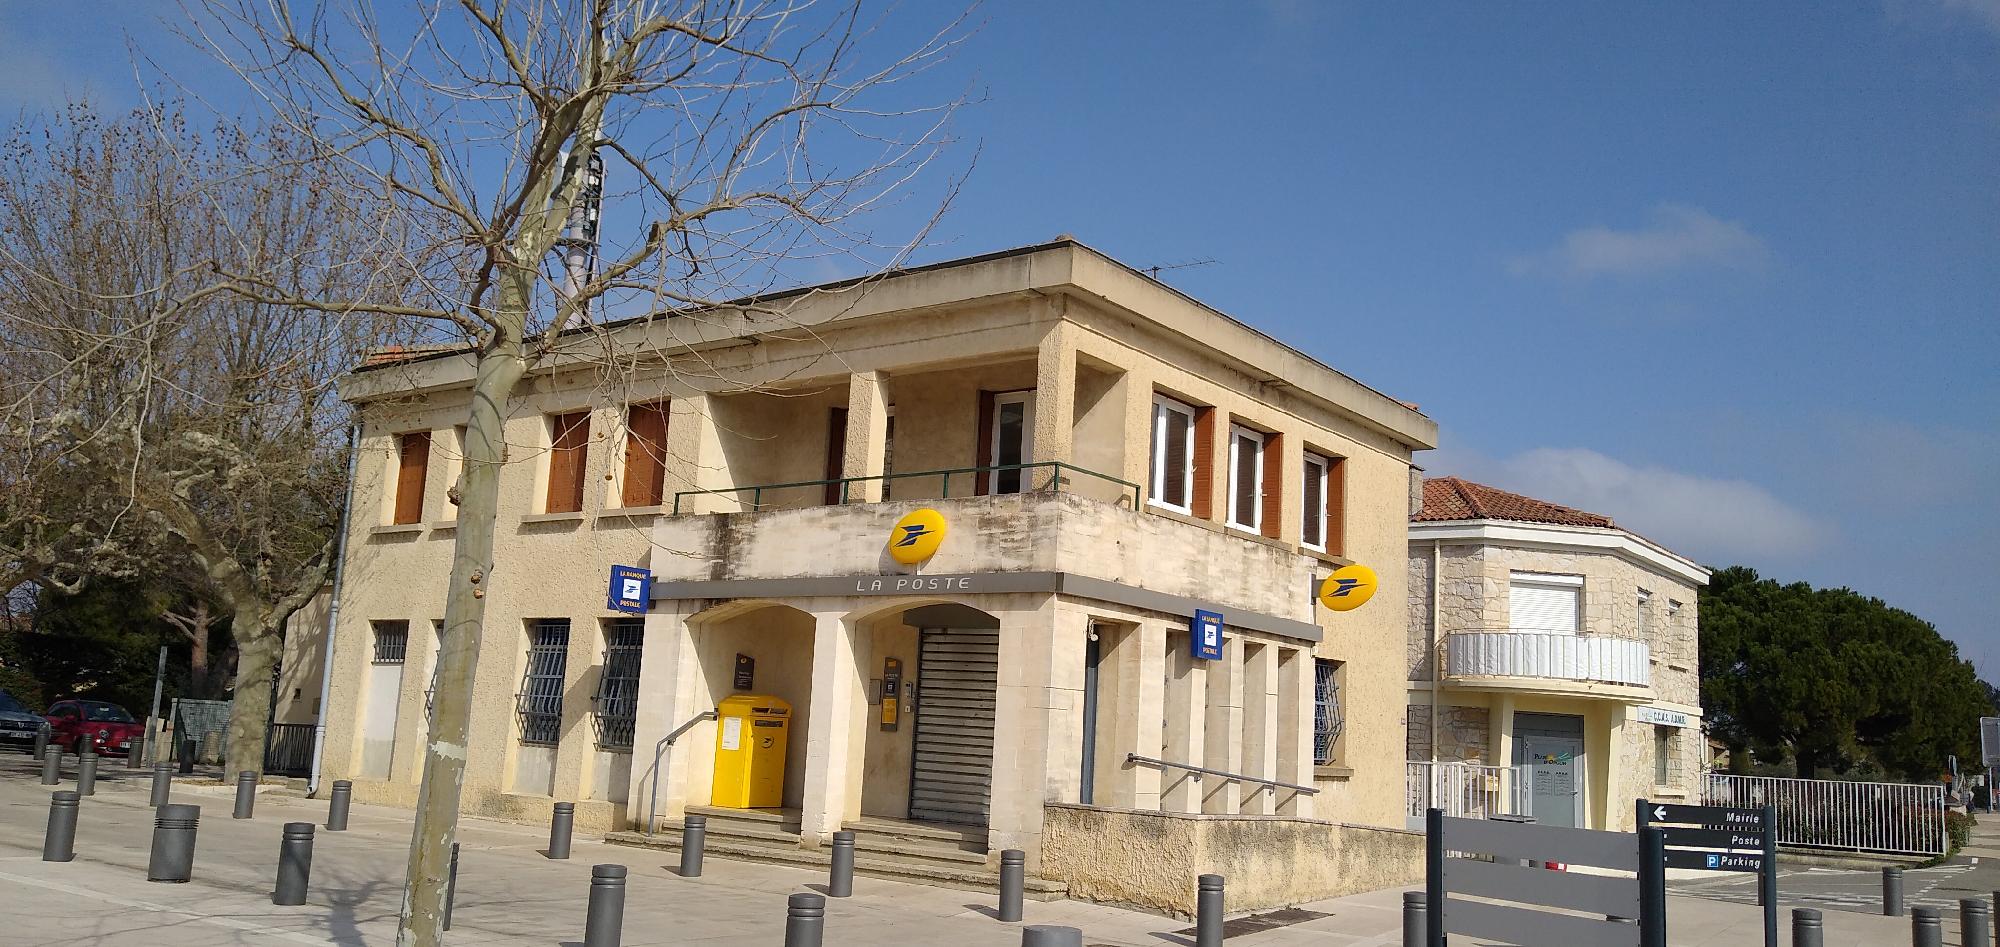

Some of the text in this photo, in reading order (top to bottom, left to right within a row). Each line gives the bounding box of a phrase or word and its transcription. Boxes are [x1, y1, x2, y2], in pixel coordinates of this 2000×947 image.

[856, 577, 971, 591] LA POSTE
[1726, 812, 1760, 823] Mairie
[1731, 835, 1760, 846] Poste
[1720, 855, 1761, 869] Parking
